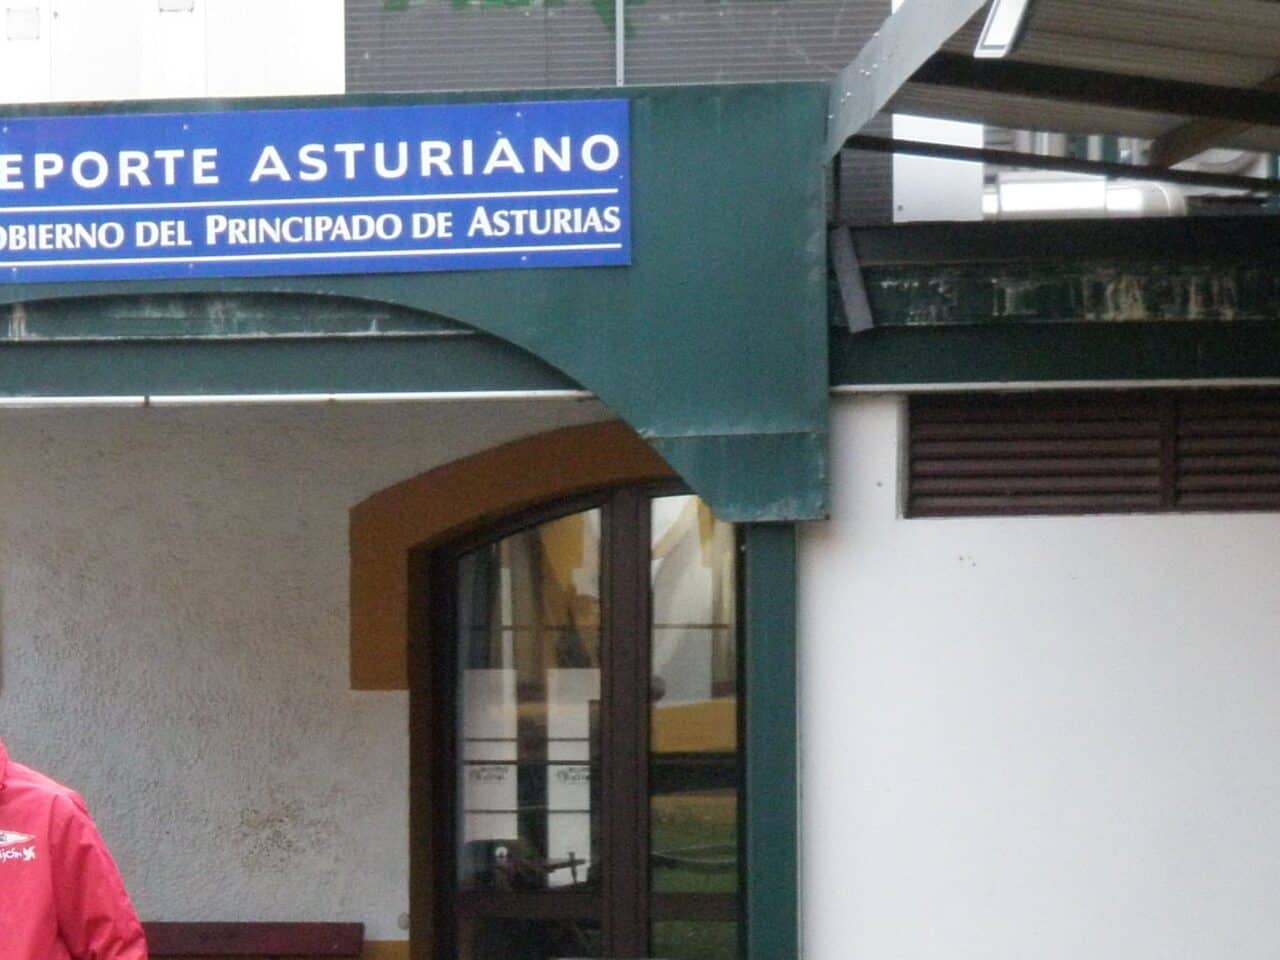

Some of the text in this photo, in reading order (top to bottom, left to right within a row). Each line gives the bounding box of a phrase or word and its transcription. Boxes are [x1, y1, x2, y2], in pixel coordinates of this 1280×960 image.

[250, 133, 620, 182] ASTURIANO
[136, 220, 192, 248] DEL
[206, 211, 402, 245] PRINCIPADO
[412, 211, 453, 240] DE
[468, 204, 622, 238] ASTURIAS
